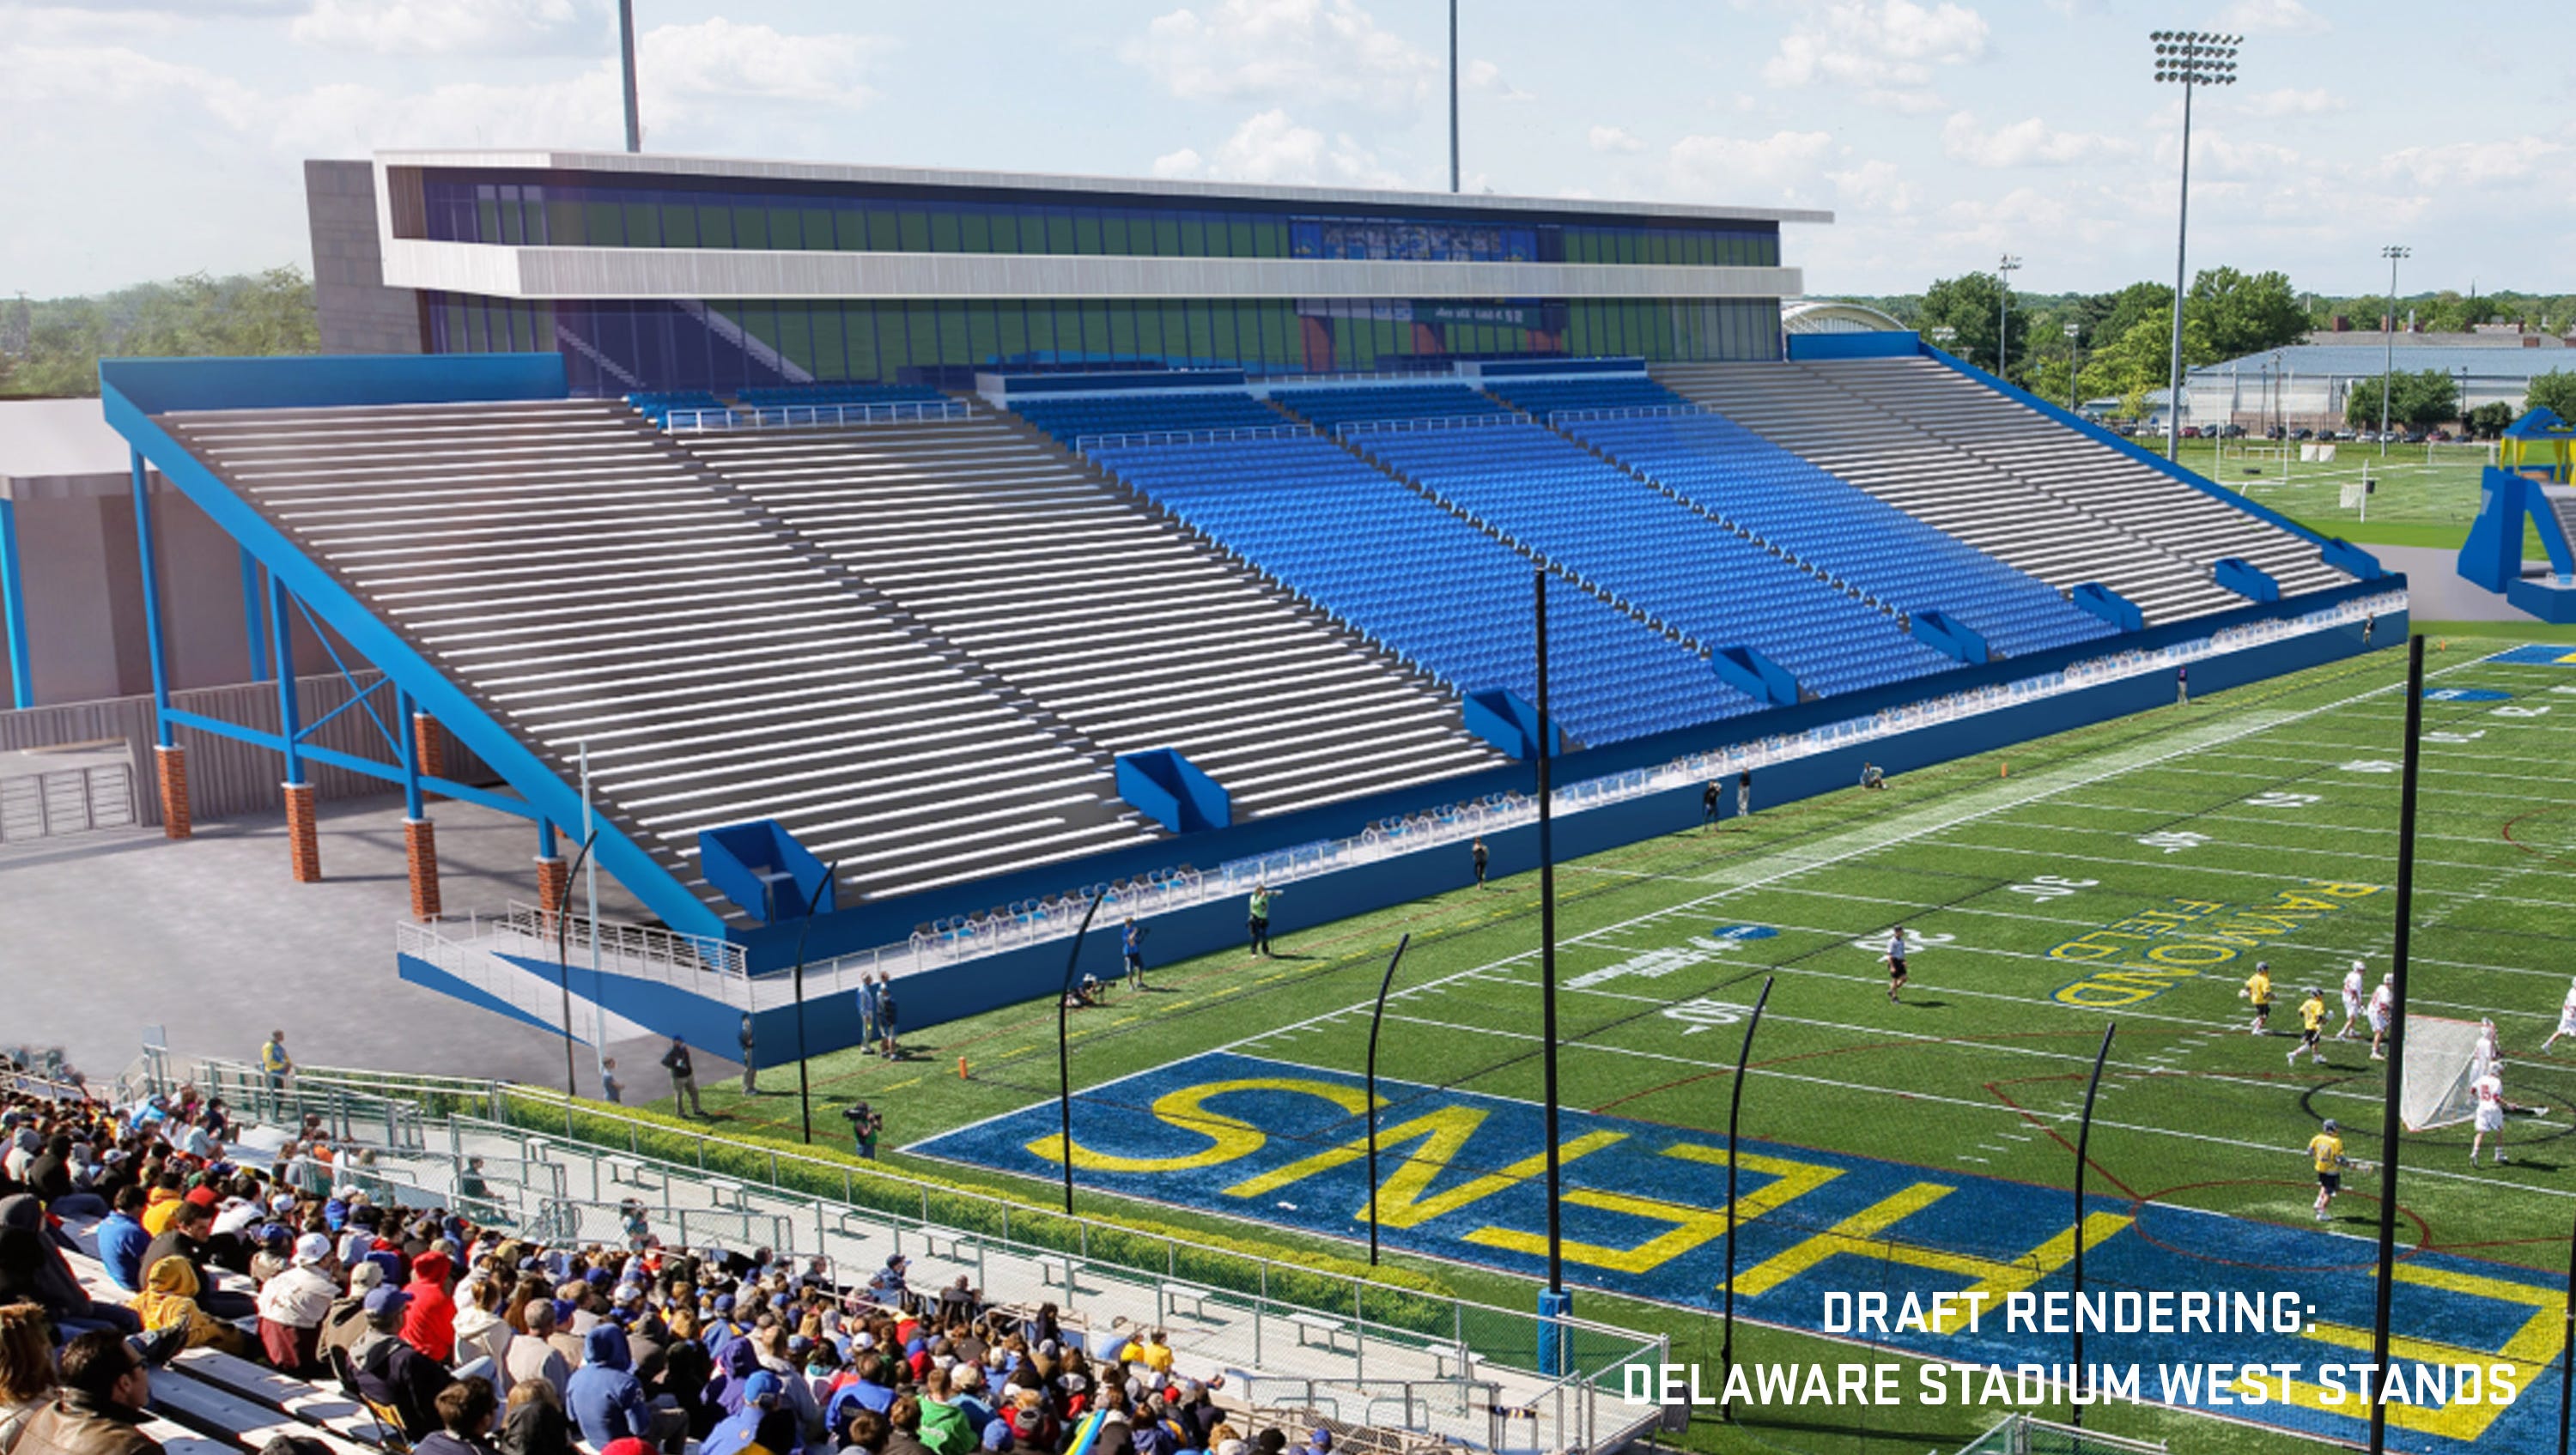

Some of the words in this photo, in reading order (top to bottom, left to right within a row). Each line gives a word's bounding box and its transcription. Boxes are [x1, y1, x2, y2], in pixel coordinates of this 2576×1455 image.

[2008, 875, 2099, 896] 30
[2049, 898, 2226, 960] FIELD
[2054, 881, 2379, 1007] RAYMOND
[1026, 1079, 2134, 1336] HENS
